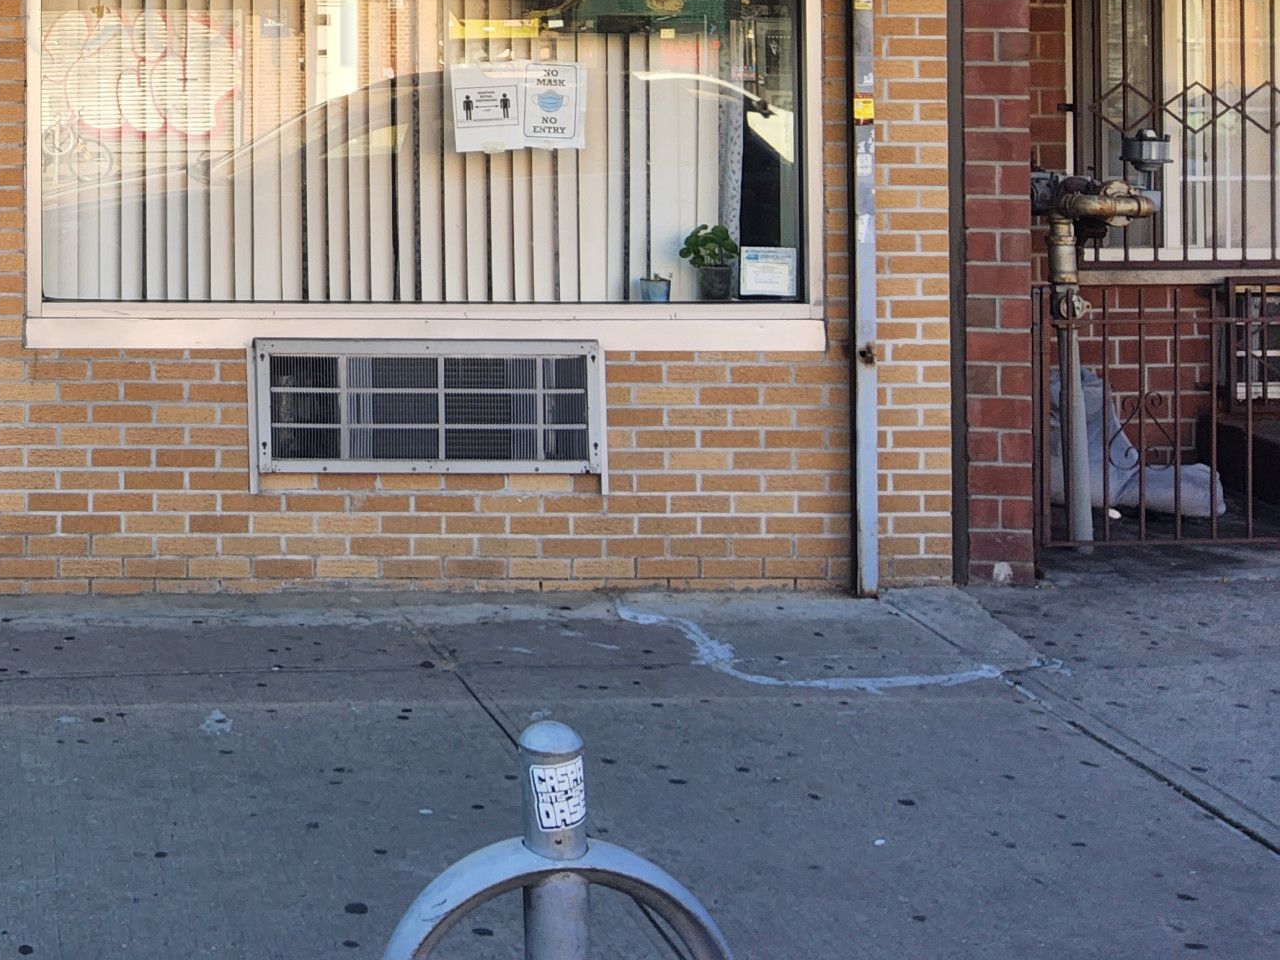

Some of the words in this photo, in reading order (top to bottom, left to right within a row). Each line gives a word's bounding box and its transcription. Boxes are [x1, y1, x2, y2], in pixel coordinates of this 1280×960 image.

[544, 69, 558, 77] NO
[536, 78, 566, 86] MASK
[542, 116, 557, 124] NO
[533, 125, 566, 134] ENTRY
